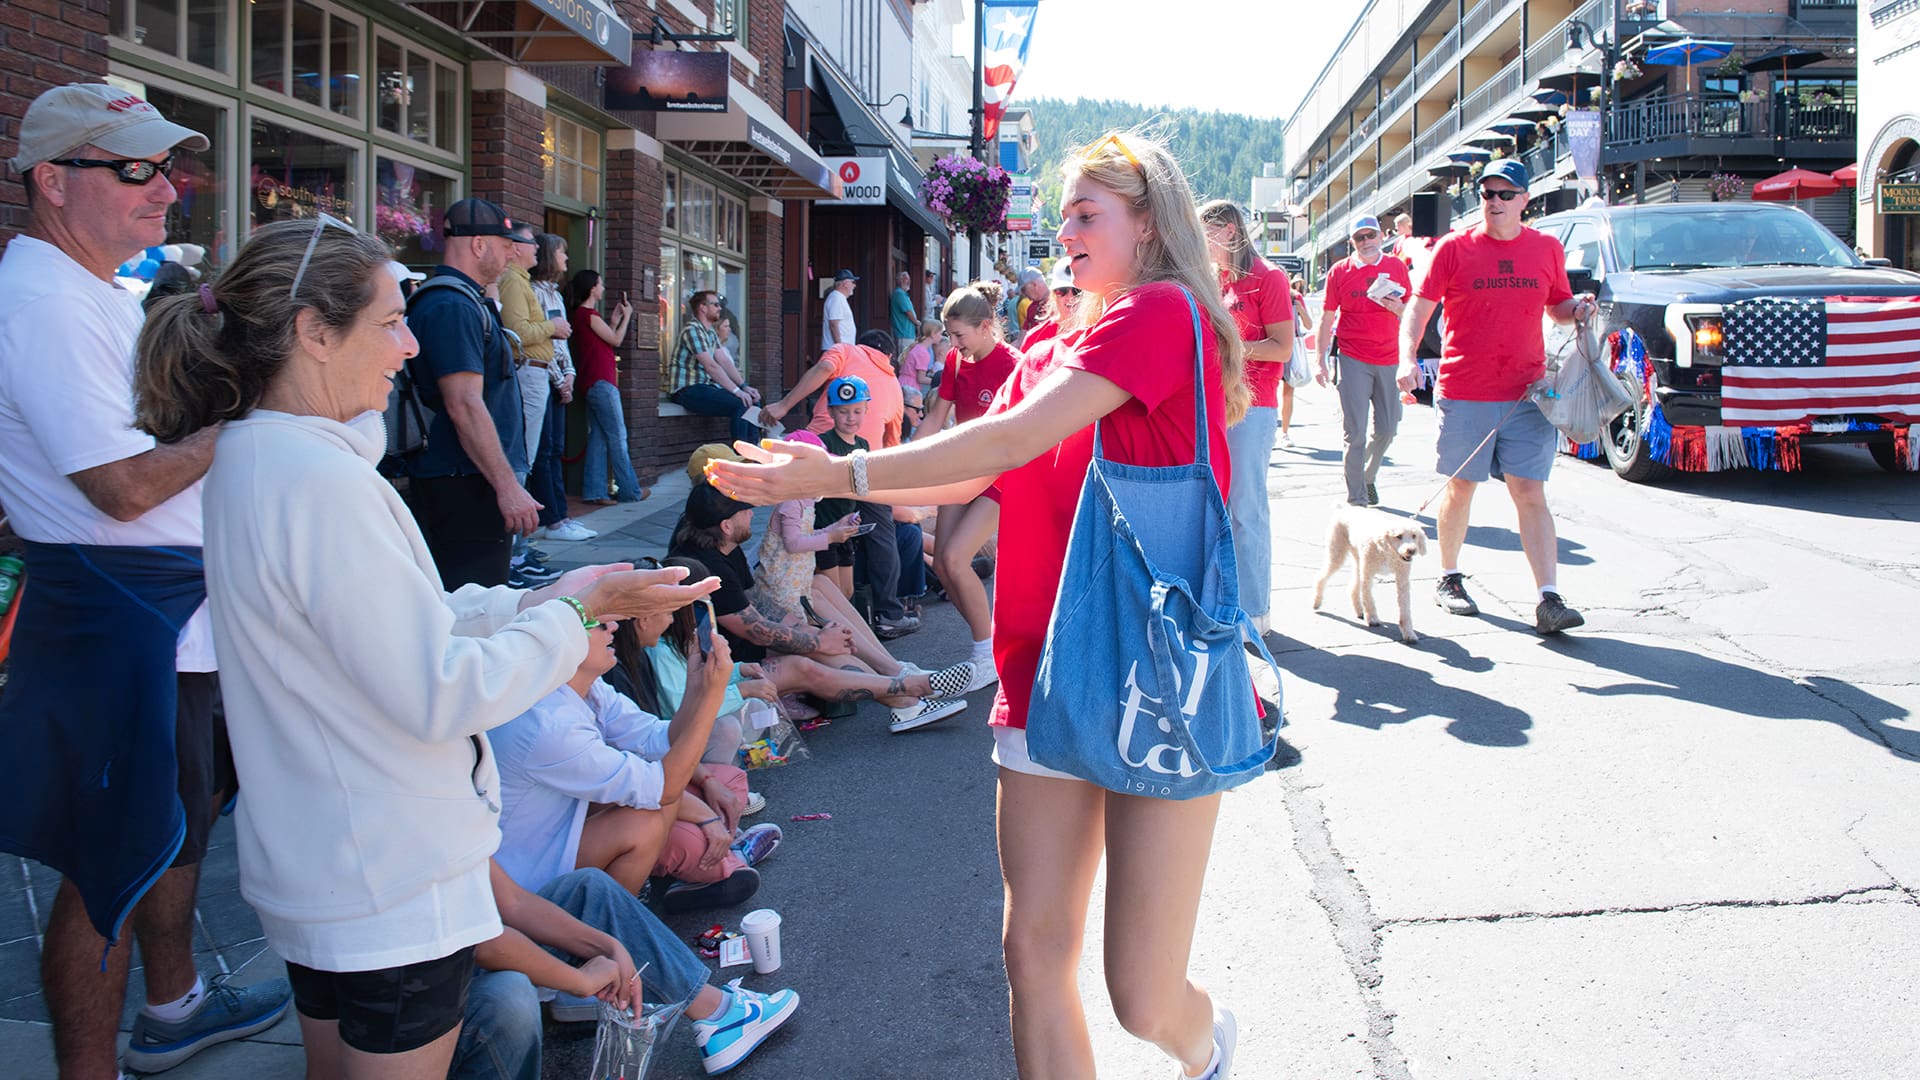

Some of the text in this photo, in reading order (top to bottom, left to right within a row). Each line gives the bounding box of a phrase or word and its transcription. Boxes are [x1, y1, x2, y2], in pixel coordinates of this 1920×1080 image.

[546, 0, 593, 30] ions
[1568, 127, 1589, 137] DAY
[1126, 778, 1171, 796] 1910
